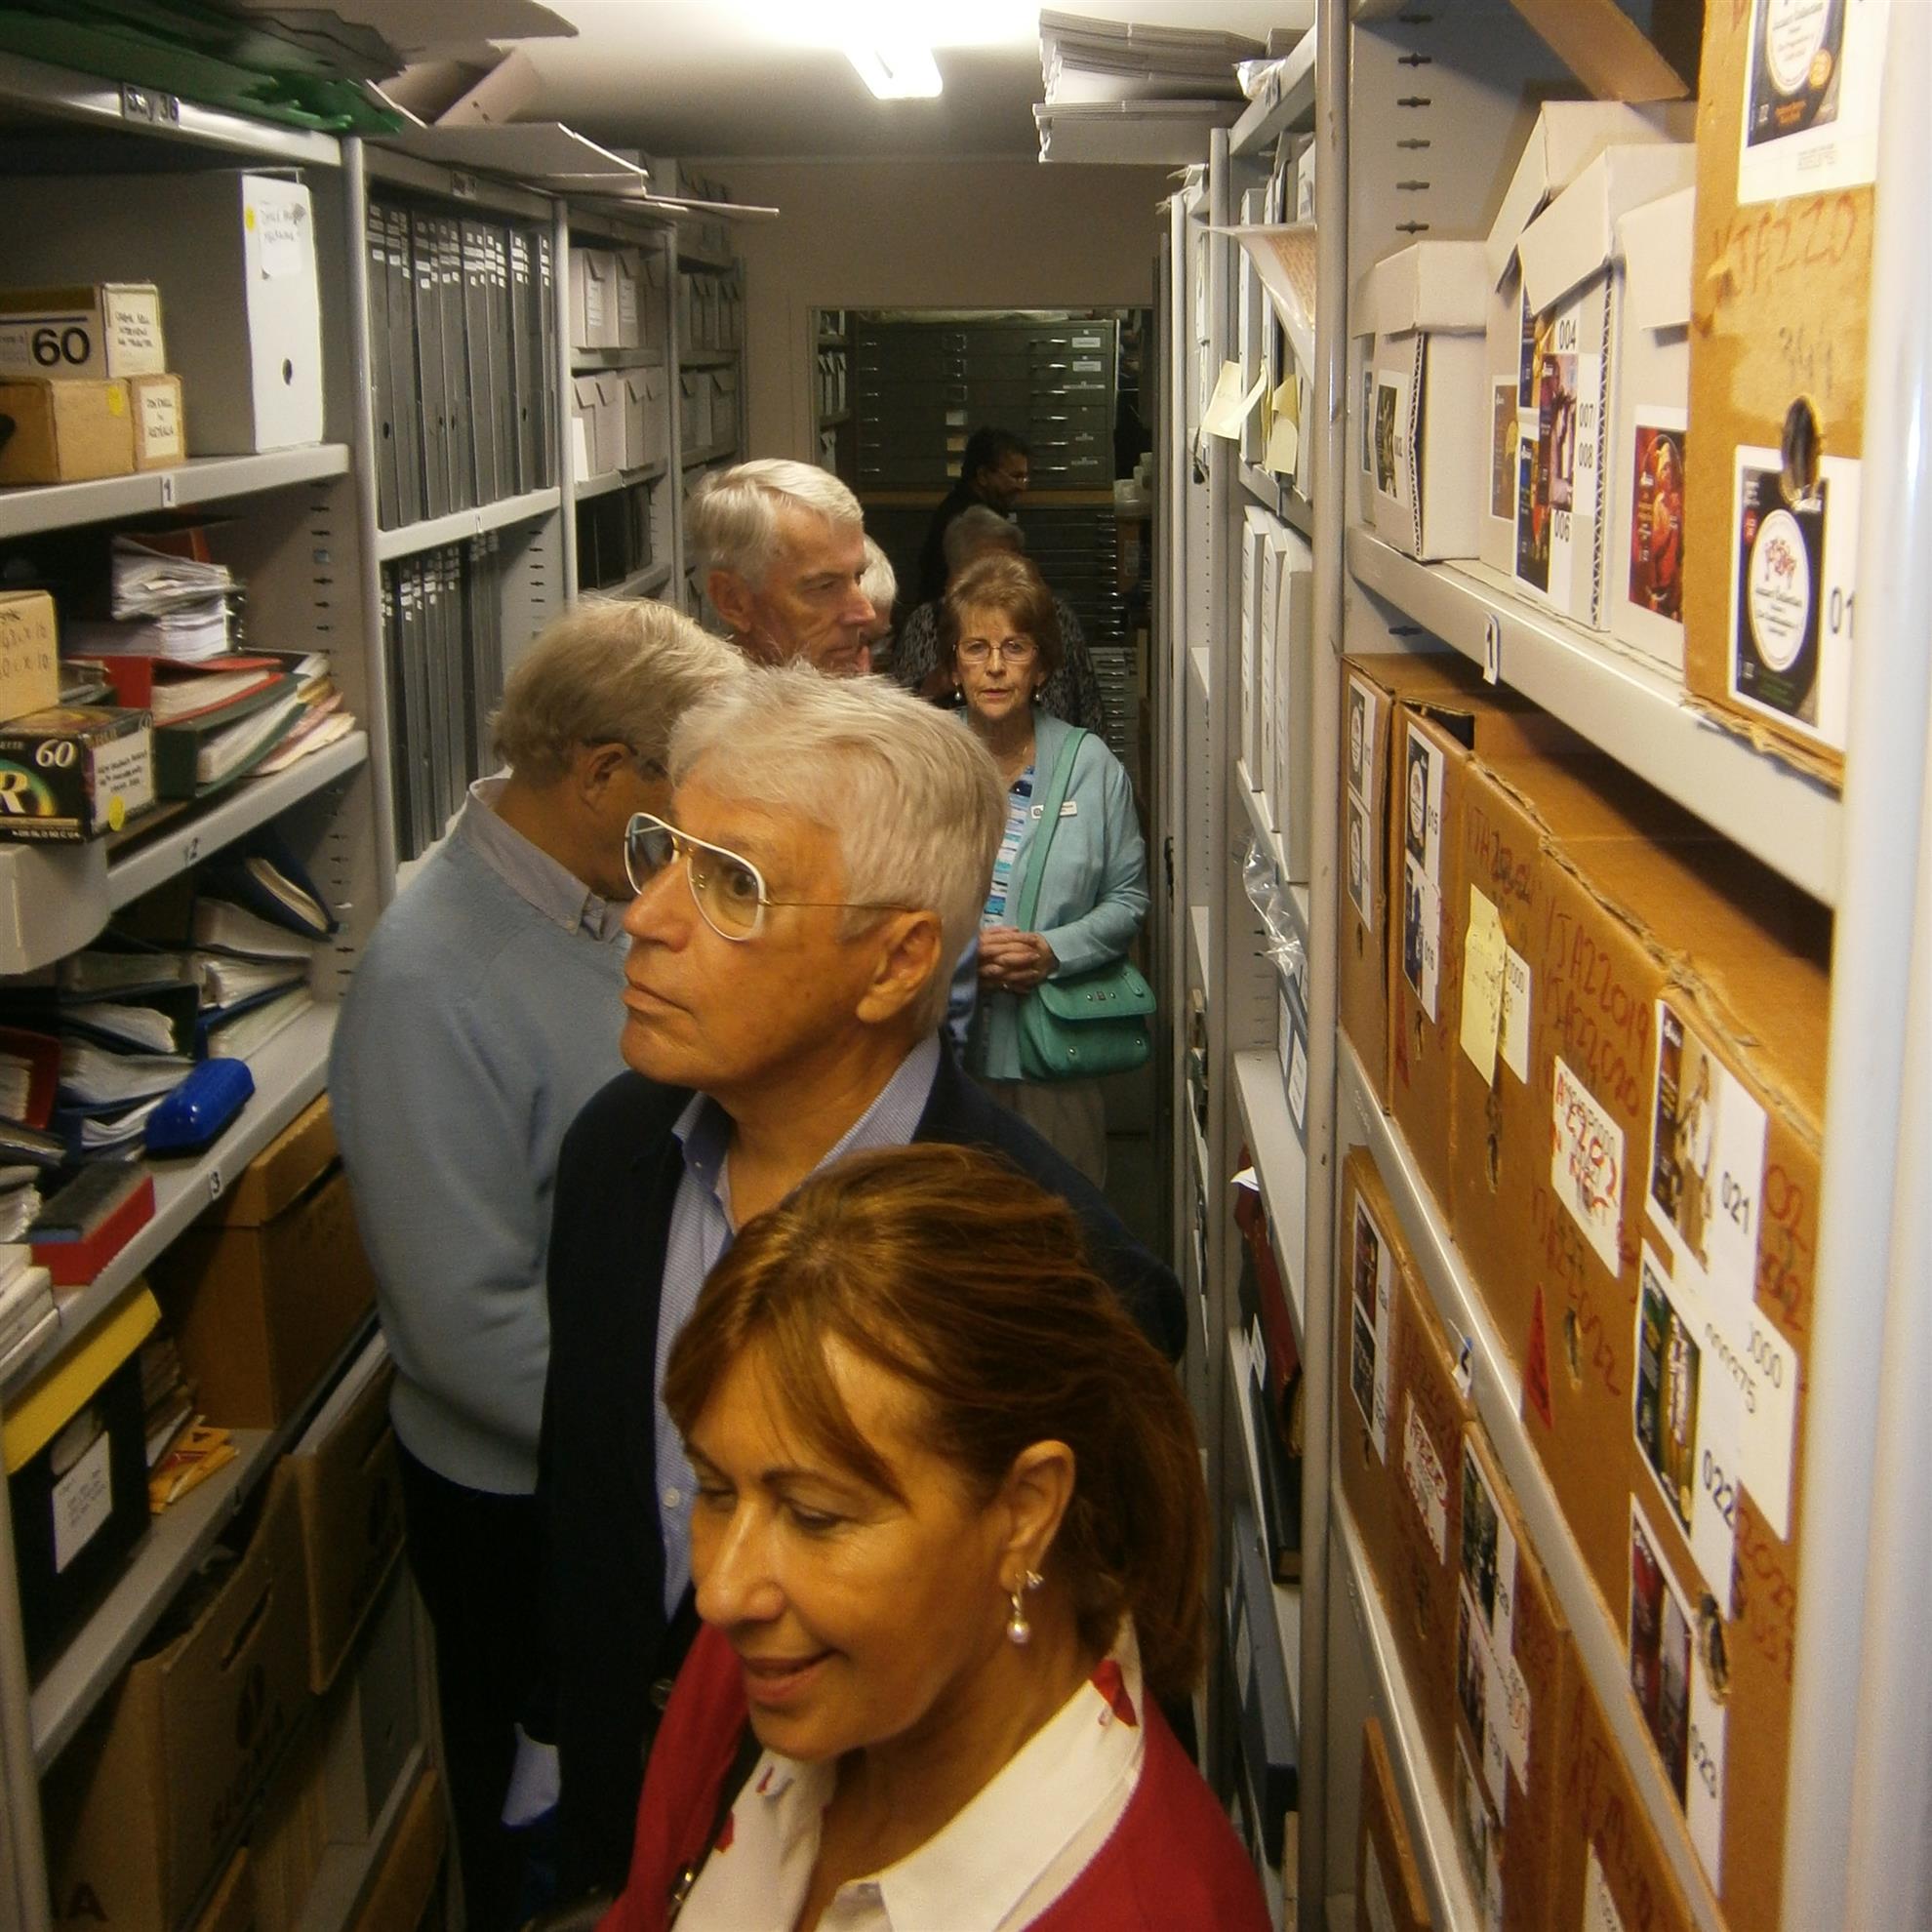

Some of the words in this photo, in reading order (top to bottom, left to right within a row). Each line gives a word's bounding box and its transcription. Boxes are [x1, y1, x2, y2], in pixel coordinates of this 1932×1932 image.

[32, 327, 91, 367] 60
[1558, 319, 1577, 350] 004
[1579, 403, 1595, 429] 007
[1578, 443, 1593, 469] 008
[163, 478, 172, 502] 1
[1553, 508, 1571, 543] 006
[1486, 623, 1494, 669] 1
[35, 739, 76, 768] 60
[1721, 1170, 1751, 1235] 021
[1702, 1448, 1735, 1529] 022
